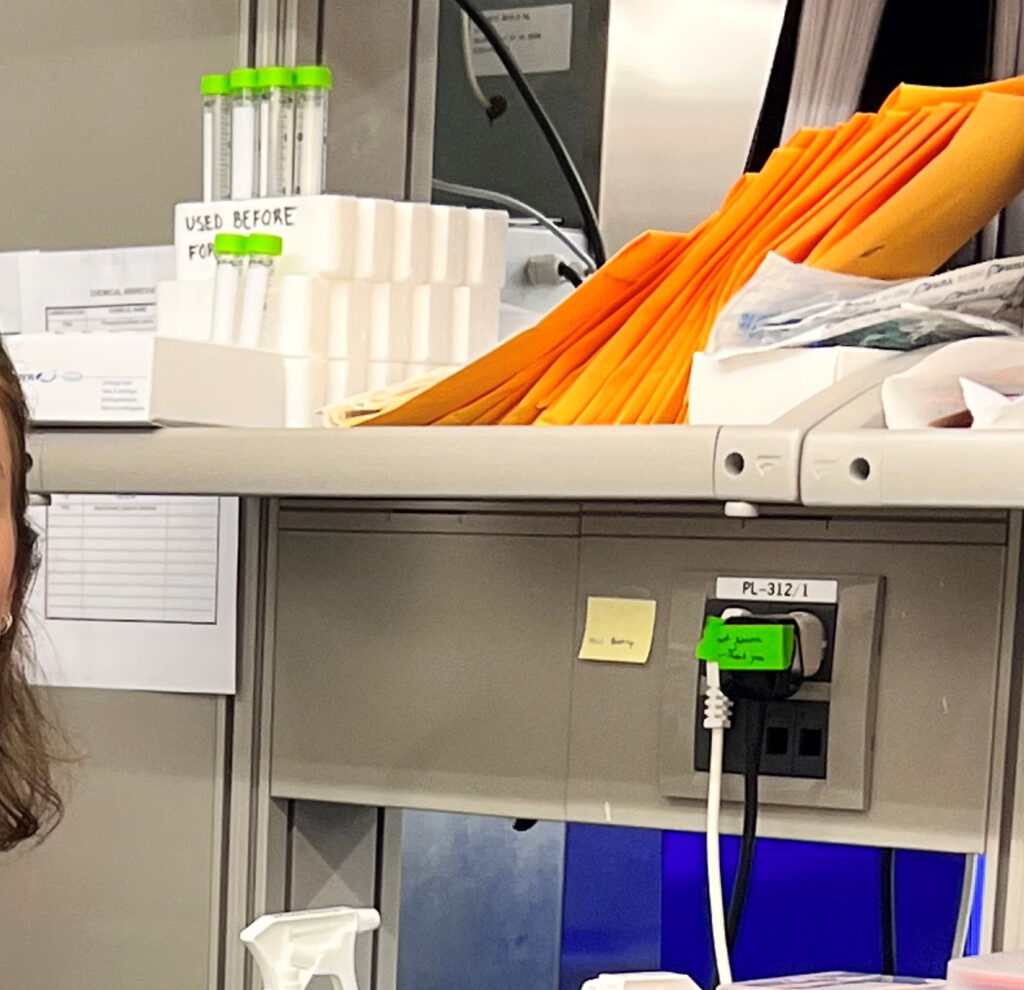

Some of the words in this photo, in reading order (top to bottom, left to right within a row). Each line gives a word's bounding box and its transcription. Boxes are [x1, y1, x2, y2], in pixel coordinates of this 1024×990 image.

[185, 213, 223, 232] USED
[233, 206, 298, 230] BEFORE
[742, 581, 808, 598] PL-312/1
